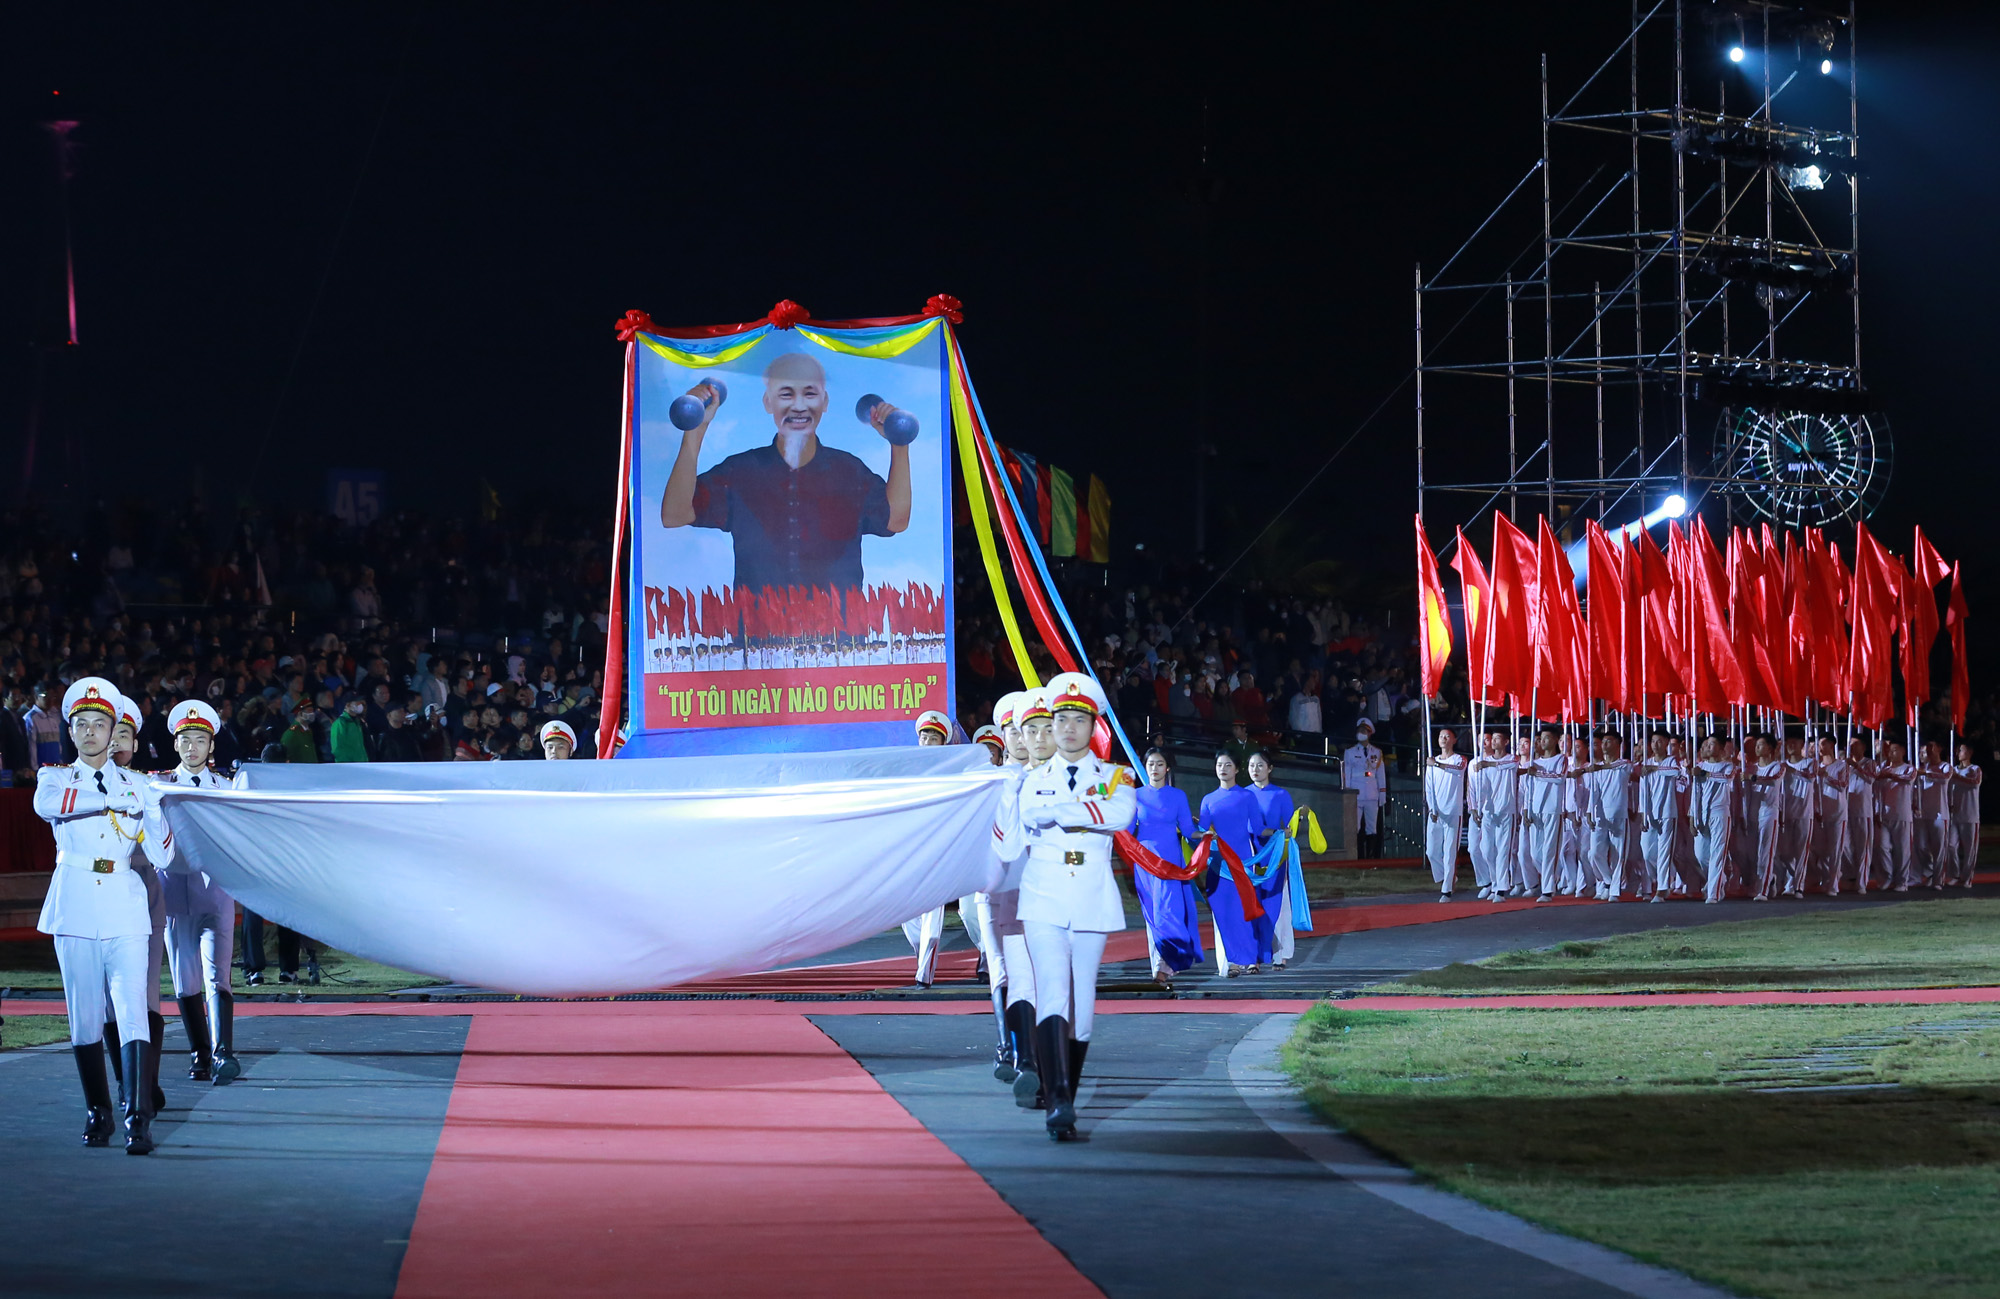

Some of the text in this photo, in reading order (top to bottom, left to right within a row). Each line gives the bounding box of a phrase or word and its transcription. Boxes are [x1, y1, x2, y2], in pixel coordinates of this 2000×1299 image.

[658, 675, 938, 722] “TỰ TÔI NGÀY NÀO CŨNG TẬP”
